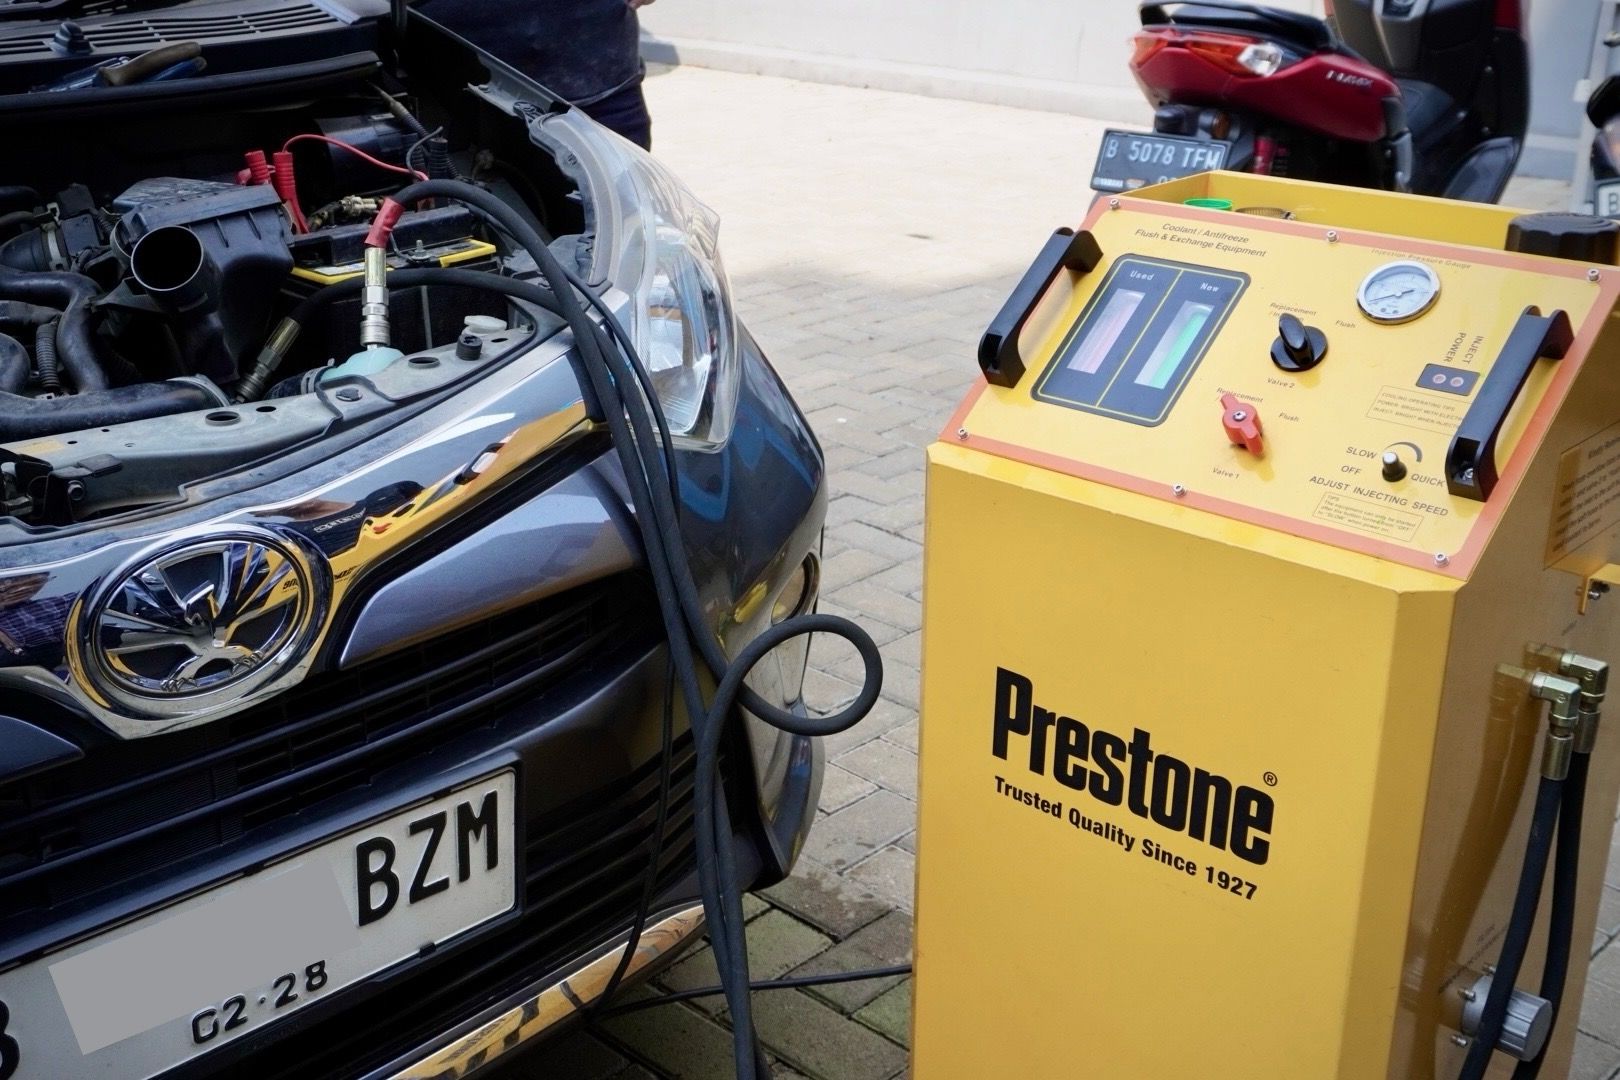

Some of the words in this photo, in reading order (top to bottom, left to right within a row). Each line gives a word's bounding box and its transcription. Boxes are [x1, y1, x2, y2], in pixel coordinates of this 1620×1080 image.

[1106, 139, 1119, 158] B
[1128, 141, 1176, 165] 5078
[1181, 147, 1221, 169] TFM
[1162, 223, 1197, 235] Coolant
[1203, 230, 1249, 244] Antifreeze
[1134, 228, 1159, 239] Flush
[1169, 234, 1214, 248] Exchange
[1215, 242, 1266, 257] Equipment
[1408, 254, 1444, 264] Pressure
[1446, 260, 1472, 269] Gauge
[1130, 270, 1154, 281] Used
[1200, 282, 1219, 292] New
[1270, 302, 1317, 316] Replacement
[1335, 319, 1356, 328] Flush
[1443, 332, 1467, 362] POWER
[1462, 335, 1485, 364] INJECT
[1267, 377, 1288, 387] Valve
[1279, 412, 1299, 422] Flush
[1346, 446, 1377, 459] SLOW
[1213, 467, 1234, 477] Valve
[1341, 465, 1362, 475] OFF
[1410, 473, 1446, 487] QUICK
[1309, 476, 1350, 490] ADJUST
[1353, 487, 1408, 506] INJECTING
[1412, 501, 1449, 516] SPEED
[992, 666, 1275, 866] Prestone
[994, 775, 1063, 819] Trusted
[1068, 807, 1136, 852] Quality
[1141, 838, 1197, 876] Since
[1205, 866, 1258, 900] 1927
[356, 790, 499, 927] BZM
